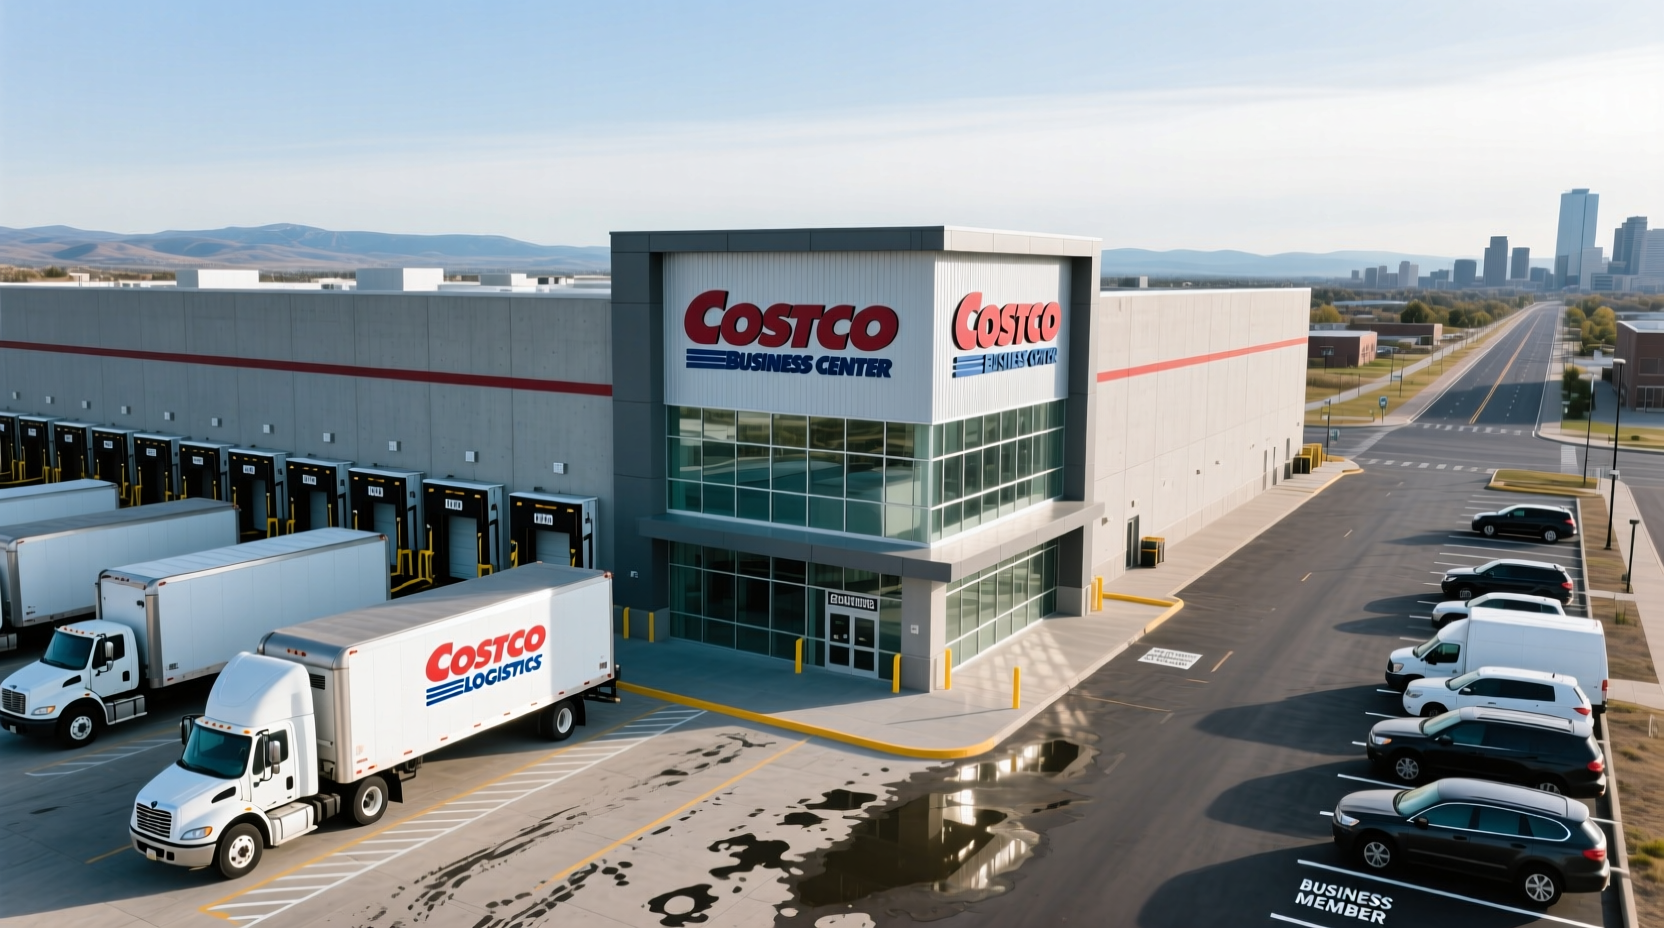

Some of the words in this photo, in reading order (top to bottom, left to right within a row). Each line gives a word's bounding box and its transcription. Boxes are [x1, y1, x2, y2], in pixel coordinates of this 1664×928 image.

[684, 289, 899, 352] COSTCO
[951, 291, 1062, 350] COSTCO
[726, 350, 814, 375] BUSINESS
[815, 355, 893, 378] CENTER
[425, 624, 546, 682] COSTCO
[463, 653, 543, 693] LOGISTICS
[1295, 892, 1387, 925] MEMBER
[1299, 878, 1394, 910] BUSINESS
